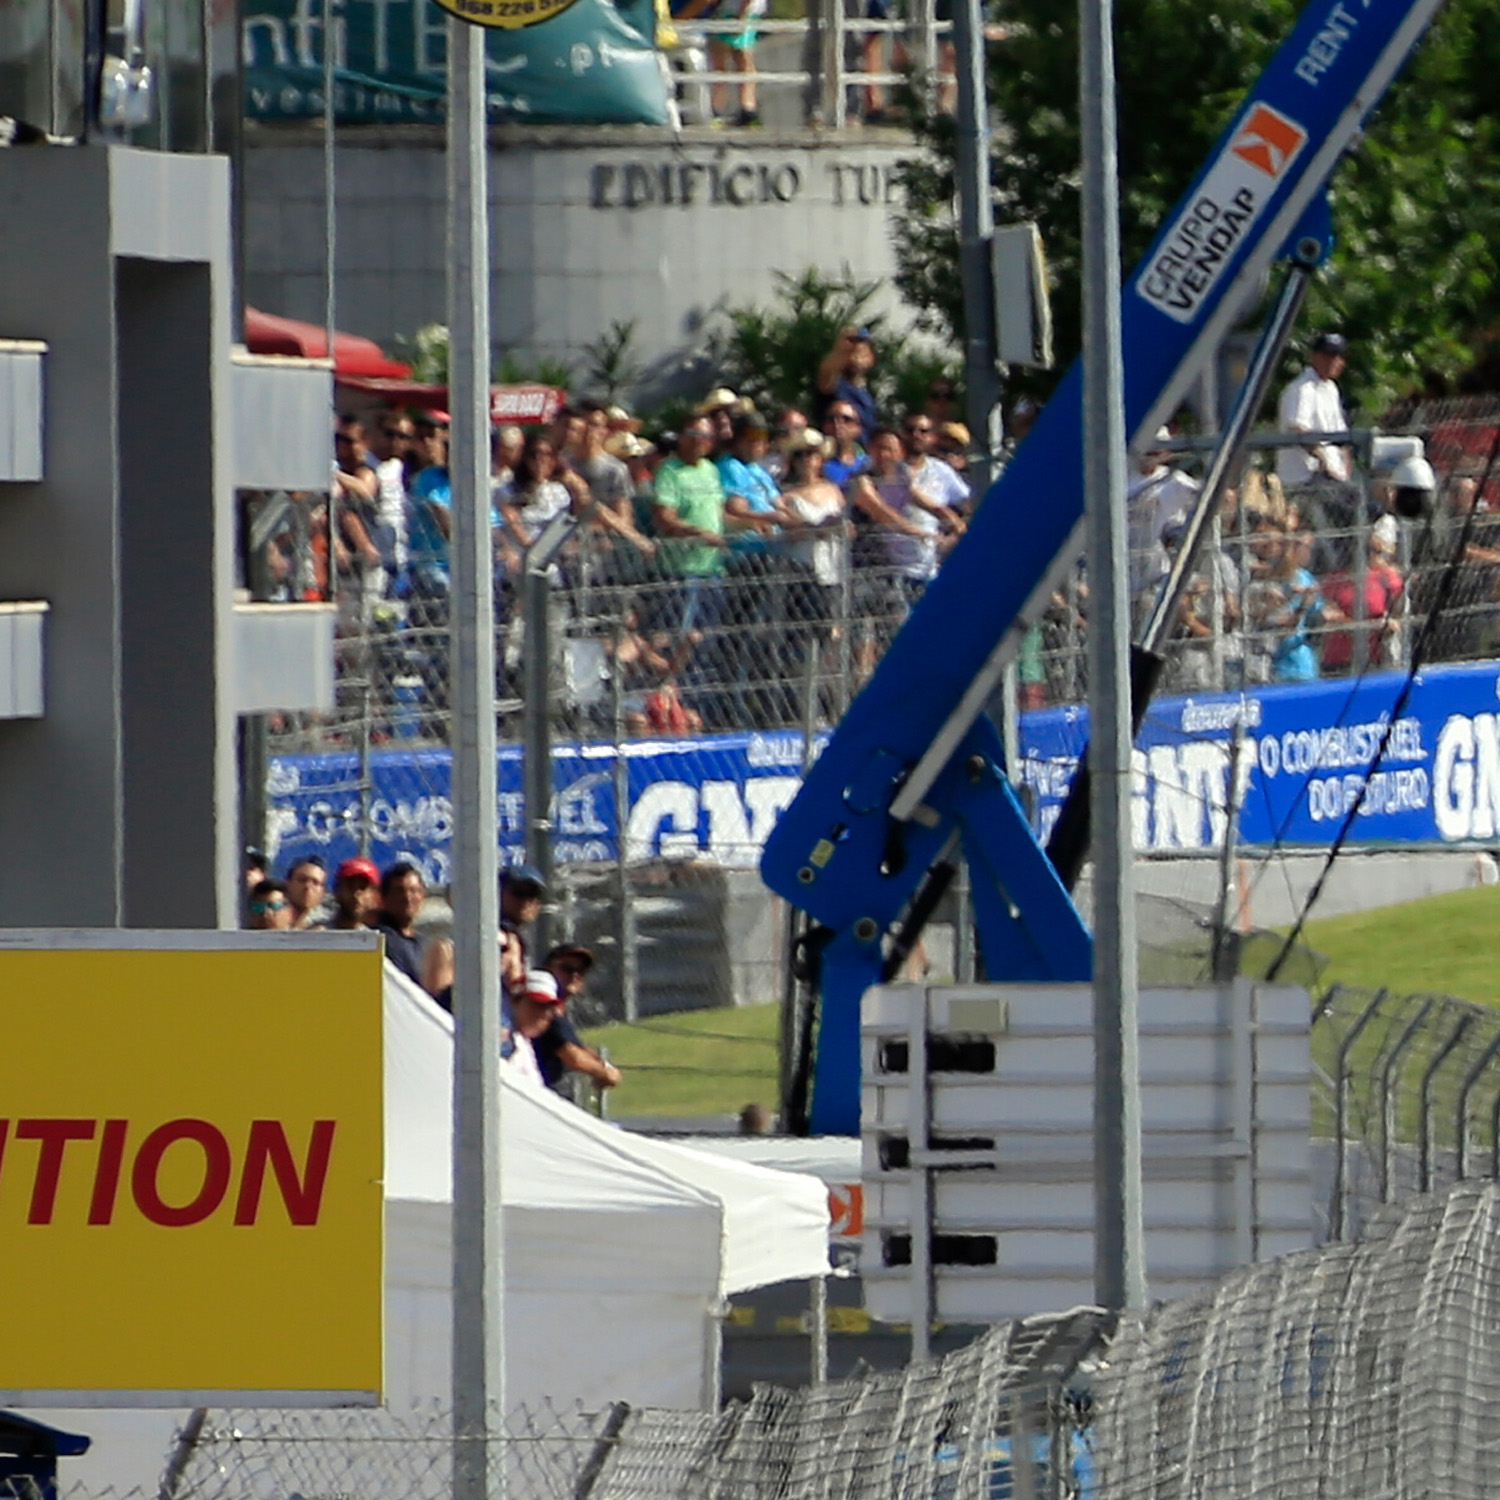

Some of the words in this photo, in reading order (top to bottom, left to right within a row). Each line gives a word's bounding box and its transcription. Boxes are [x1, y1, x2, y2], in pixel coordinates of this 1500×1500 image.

[1294, 2, 1358, 86] RENT
[1145, 195, 1220, 300] GRUPO
[1168, 187, 1254, 310] VENDAP
[0, 1118, 337, 1227] TION
